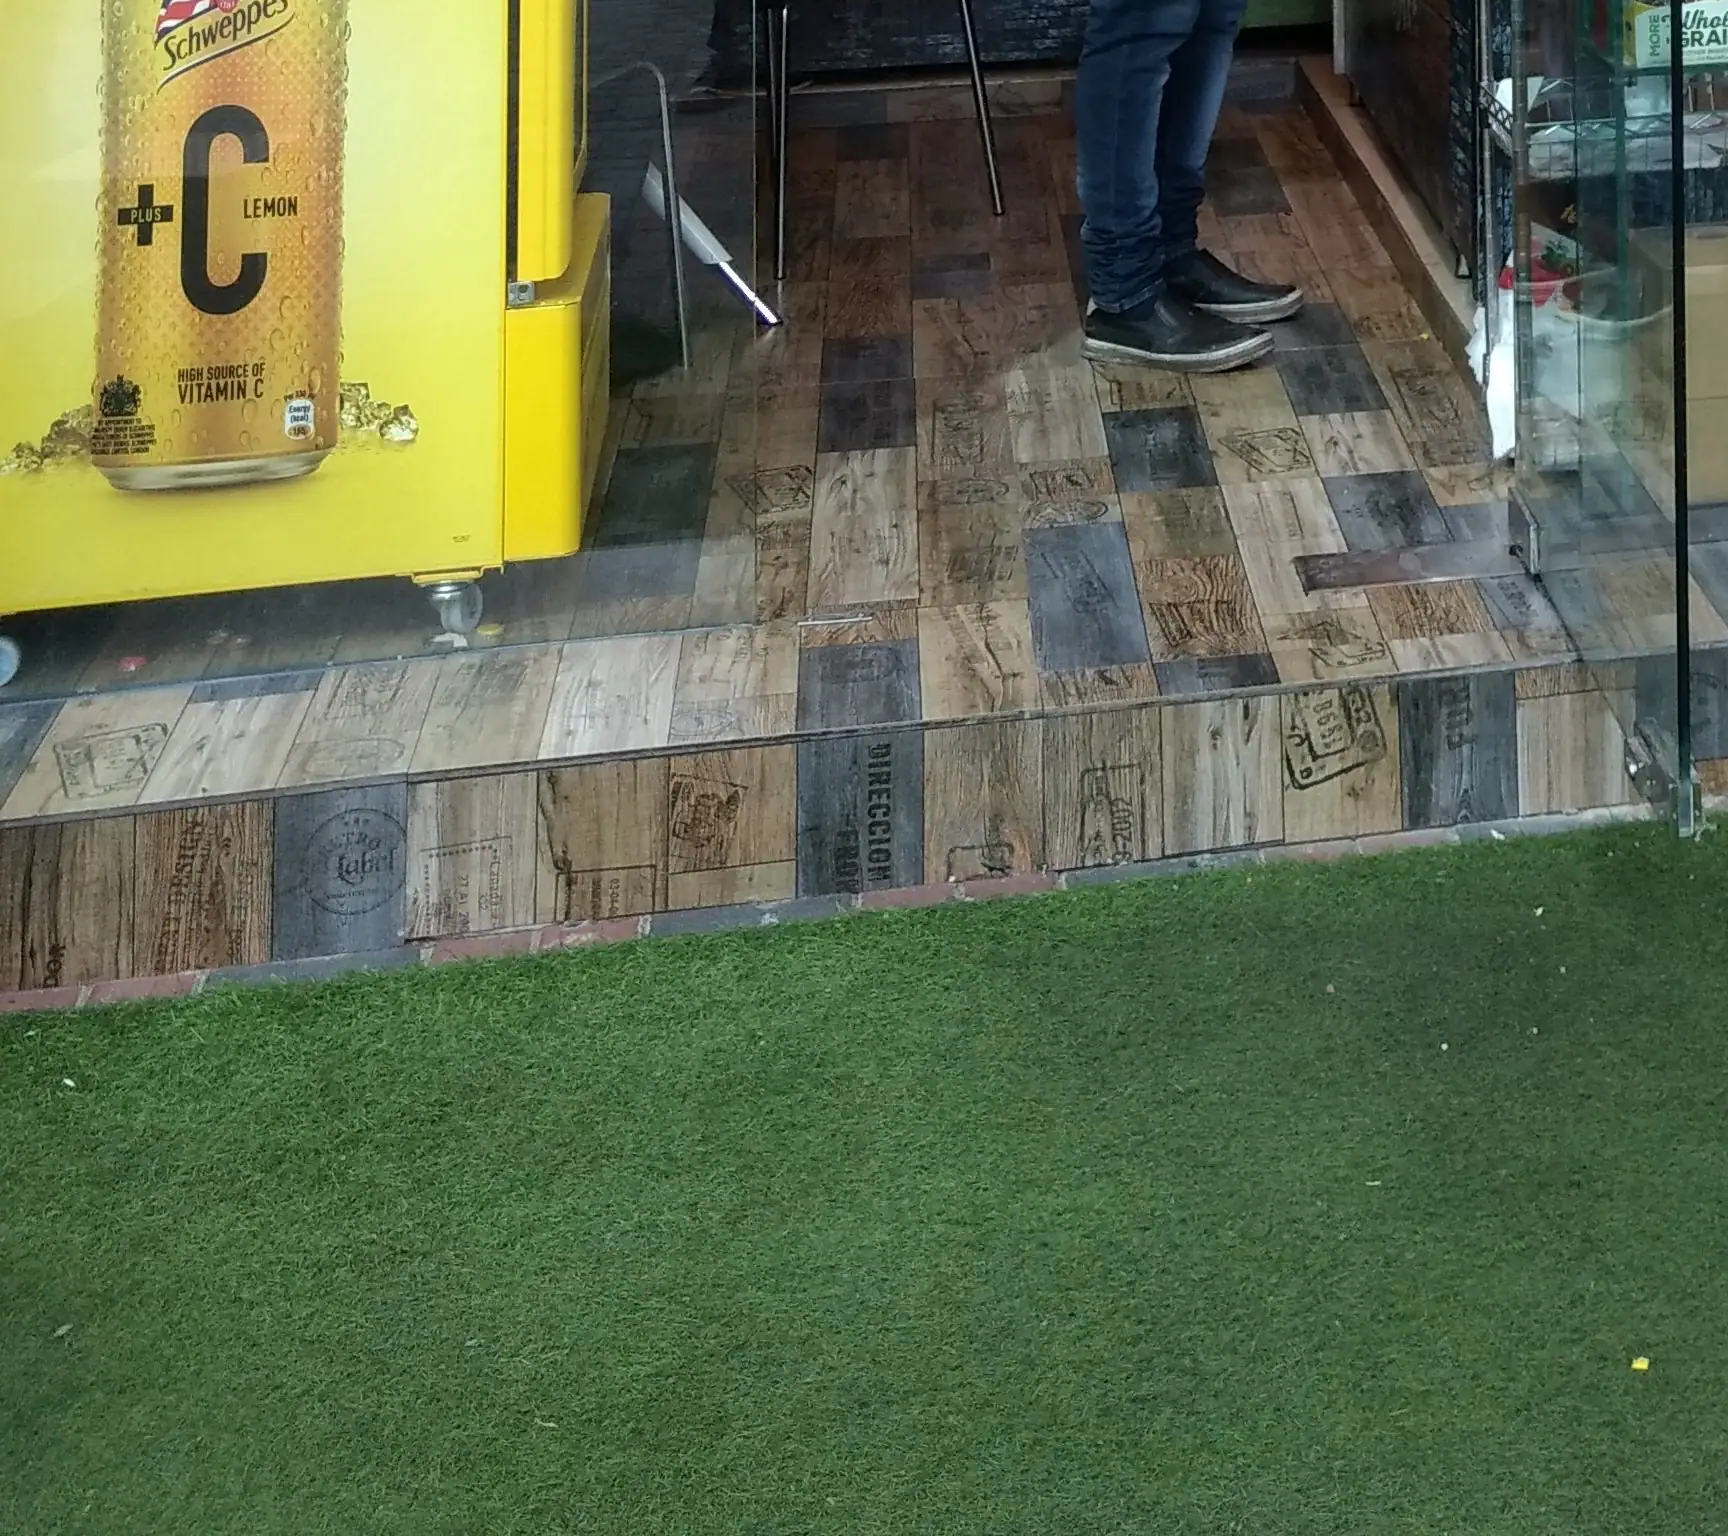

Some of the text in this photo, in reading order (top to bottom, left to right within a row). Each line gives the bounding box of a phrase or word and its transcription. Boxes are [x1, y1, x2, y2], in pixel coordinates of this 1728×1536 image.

[1649, 14, 1660, 56] MORE
[130, 207, 162, 223] PLUS
[180, 104, 270, 315] C
[243, 195, 299, 219] LEMON
[177, 362, 266, 383] HIGH SOURCE OF
[177, 378, 265, 405] VITAMIN C
